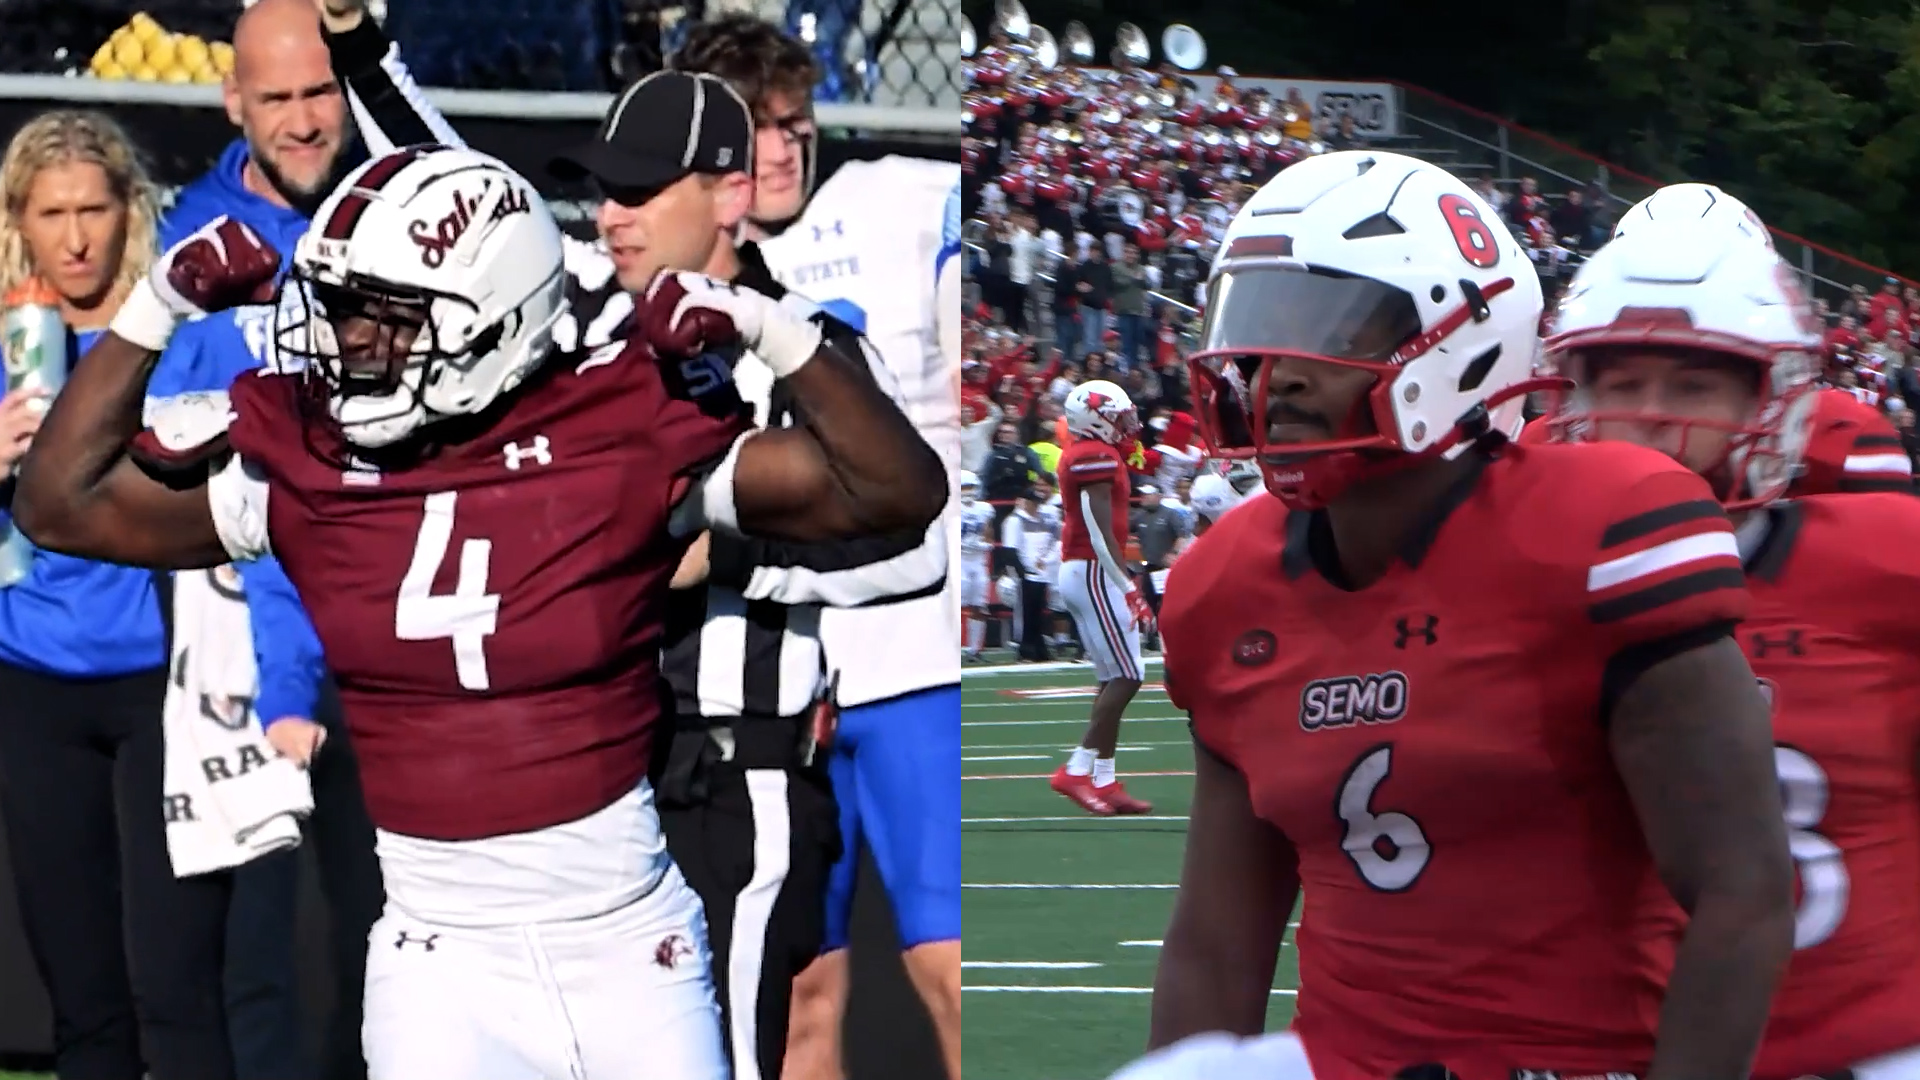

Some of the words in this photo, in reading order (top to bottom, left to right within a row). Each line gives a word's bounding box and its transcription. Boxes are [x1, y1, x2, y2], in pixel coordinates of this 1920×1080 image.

[793, 255, 861, 285] STATE
[1437, 193, 1500, 270] 6
[395, 490, 501, 691] 4
[1300, 671, 1408, 732] SEMO
[1334, 742, 1434, 893] 6
